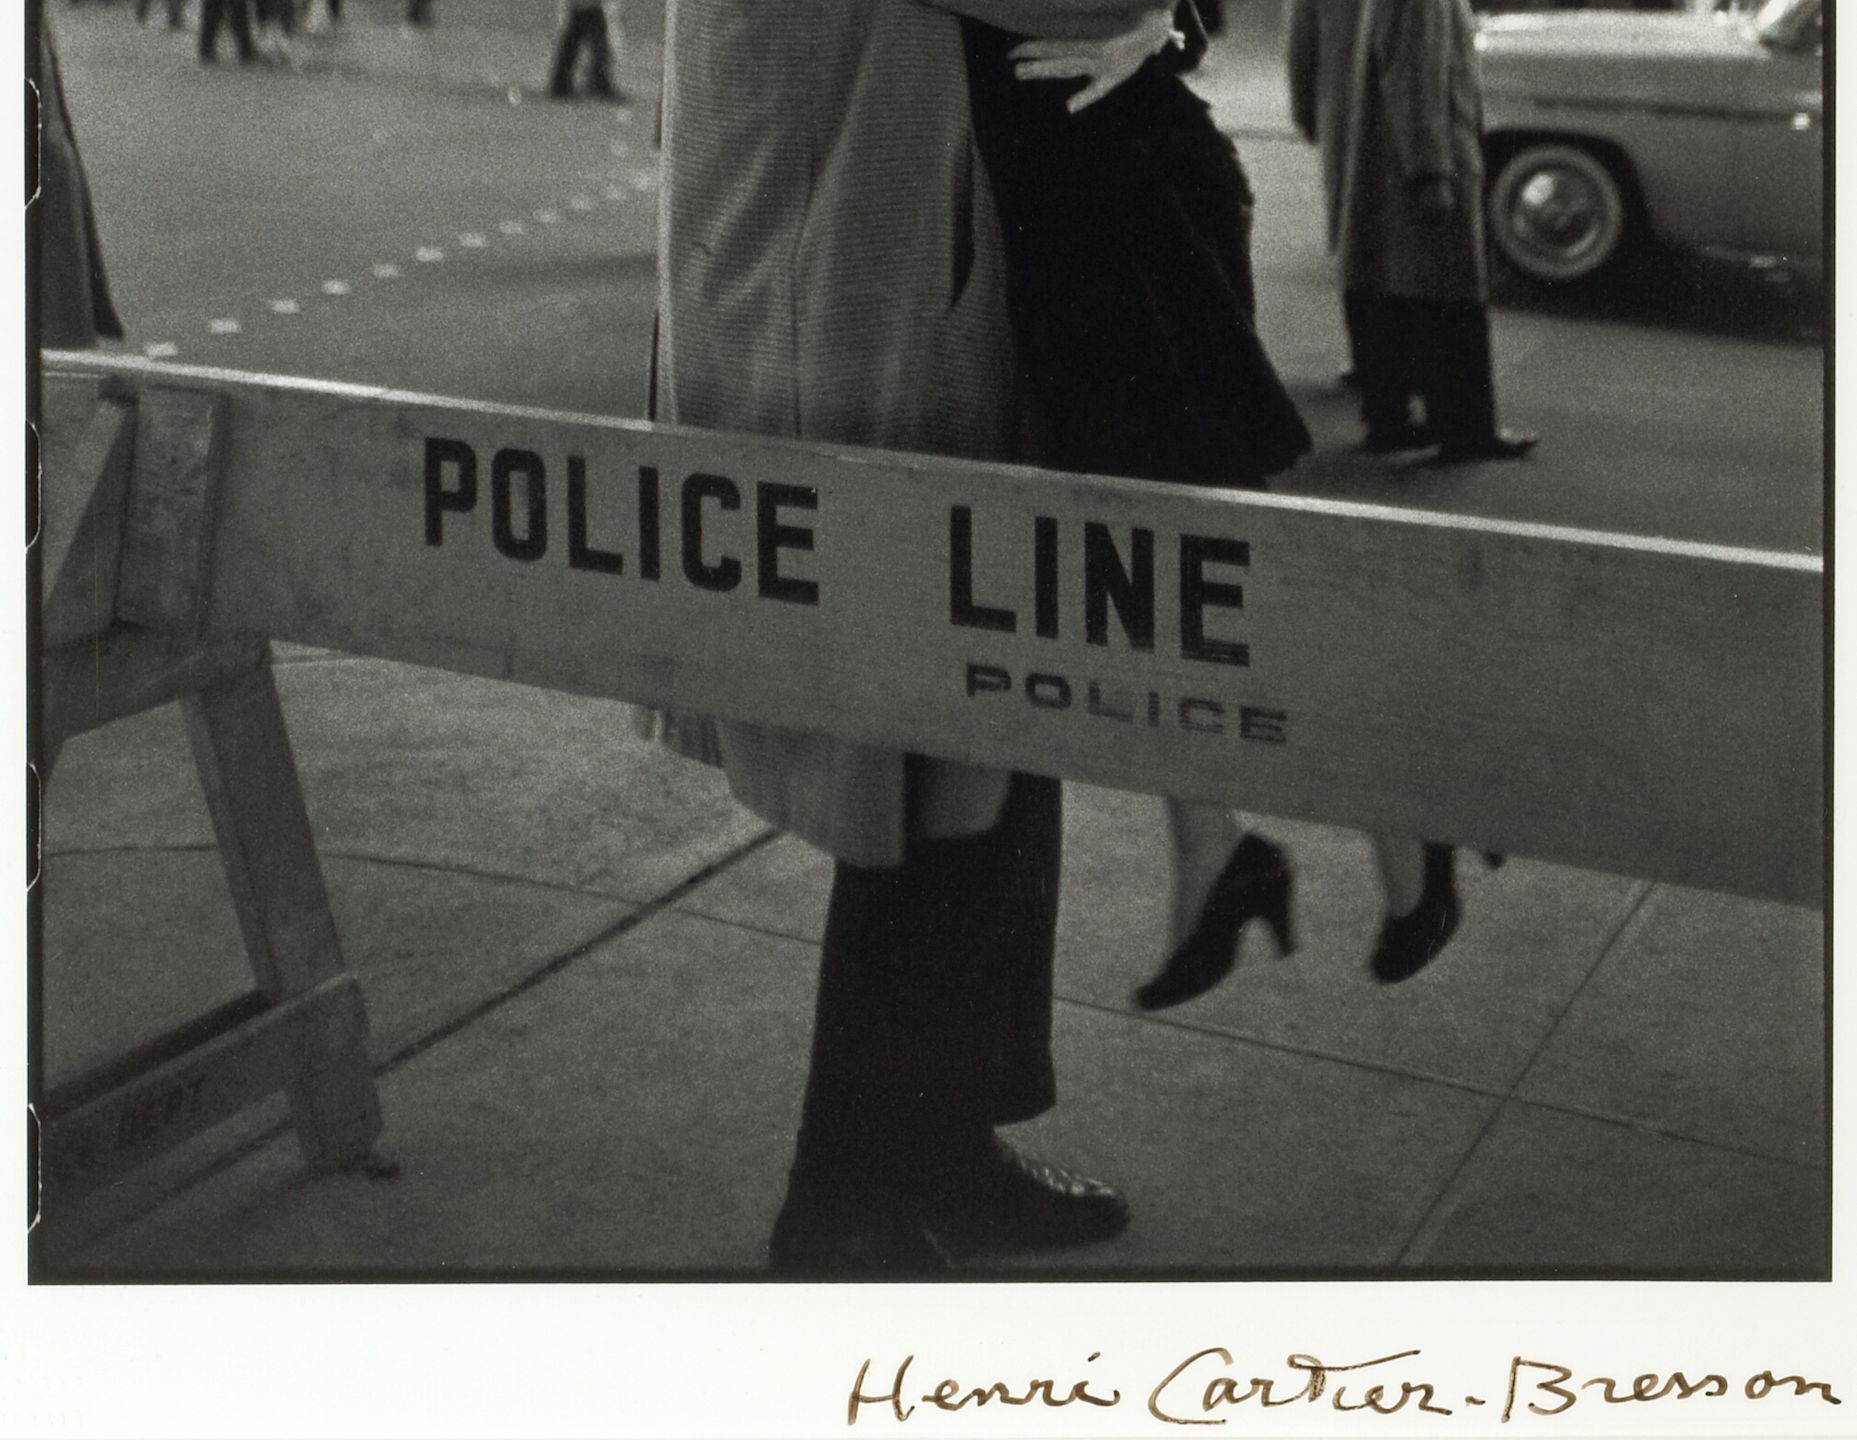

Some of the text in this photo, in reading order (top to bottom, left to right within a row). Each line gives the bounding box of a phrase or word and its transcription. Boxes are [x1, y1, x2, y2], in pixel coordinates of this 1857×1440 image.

[424, 436, 1251, 668] POLICE LINE
[965, 662, 1289, 745] POLICE
[846, 1353, 1121, 1427] Henri
